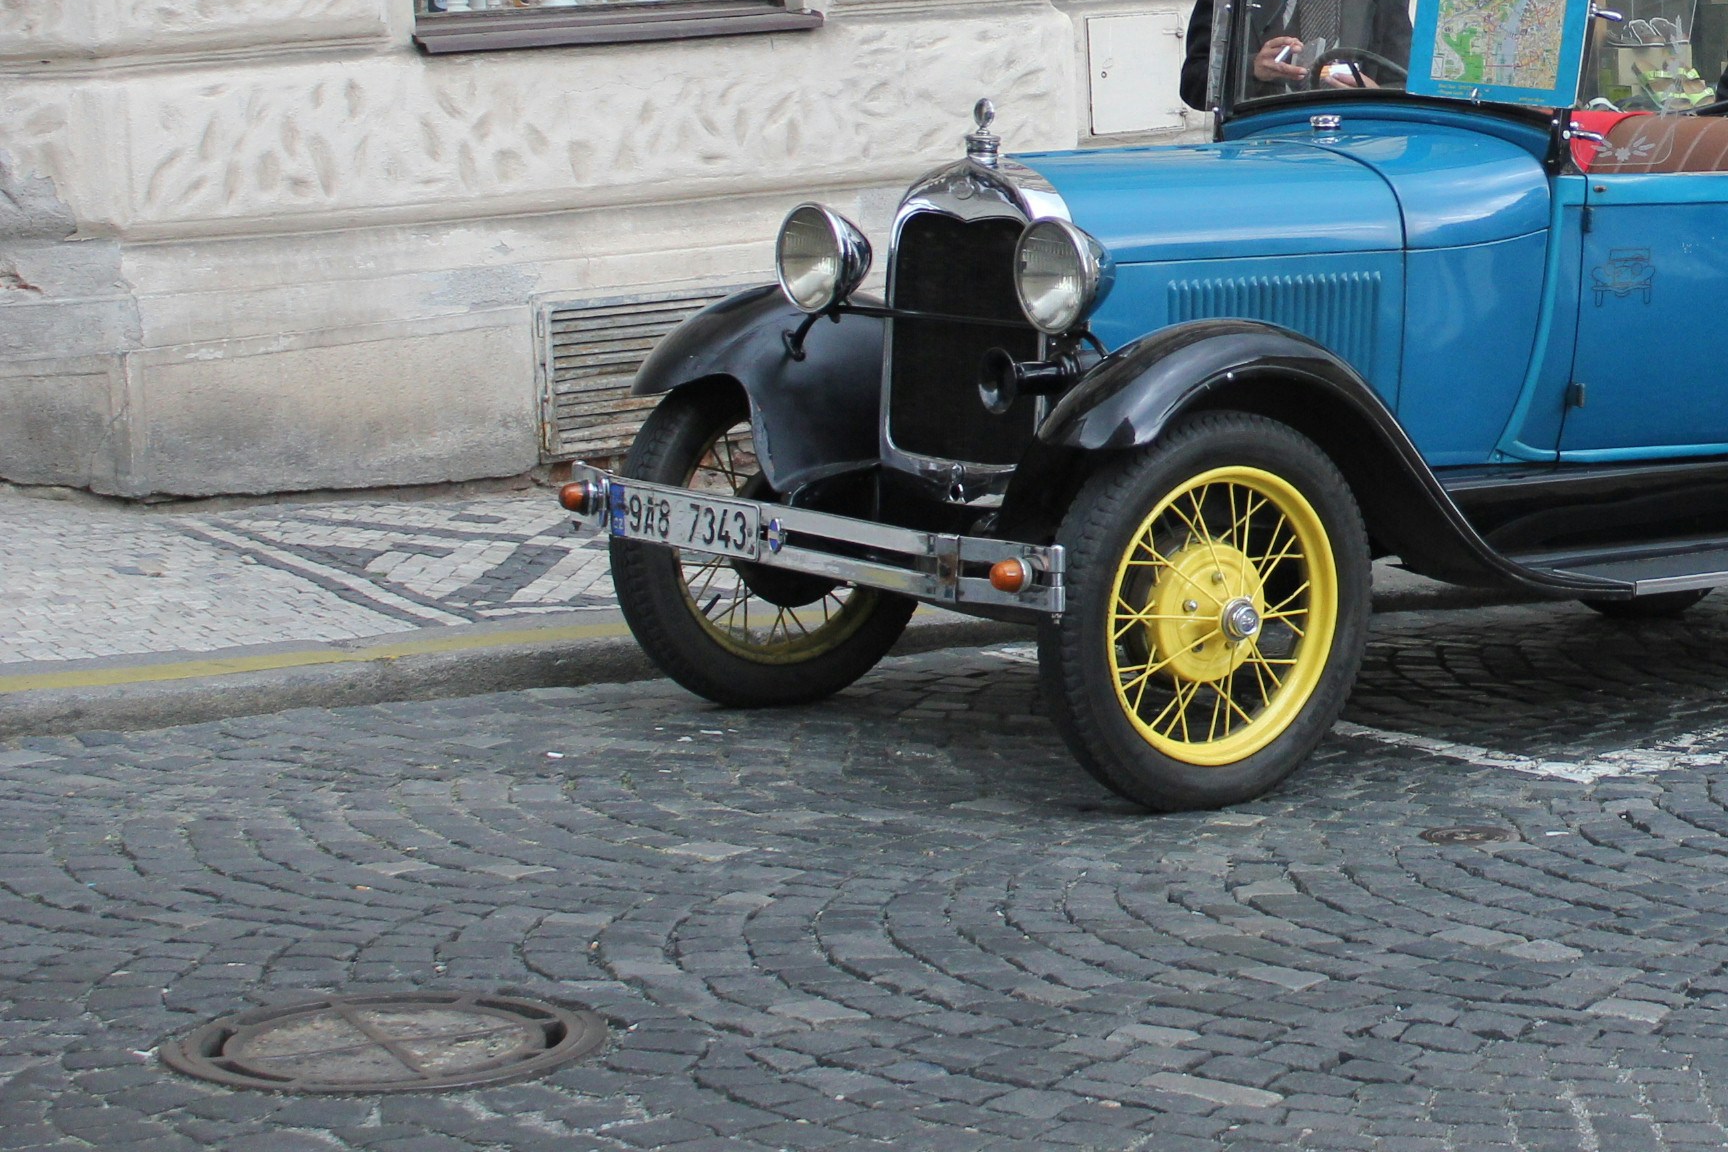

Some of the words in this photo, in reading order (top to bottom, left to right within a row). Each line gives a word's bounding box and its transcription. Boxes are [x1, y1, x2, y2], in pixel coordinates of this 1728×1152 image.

[613, 518, 623, 530] CZ
[629, 495, 671, 539] 9A8
[689, 503, 747, 551] 7343
